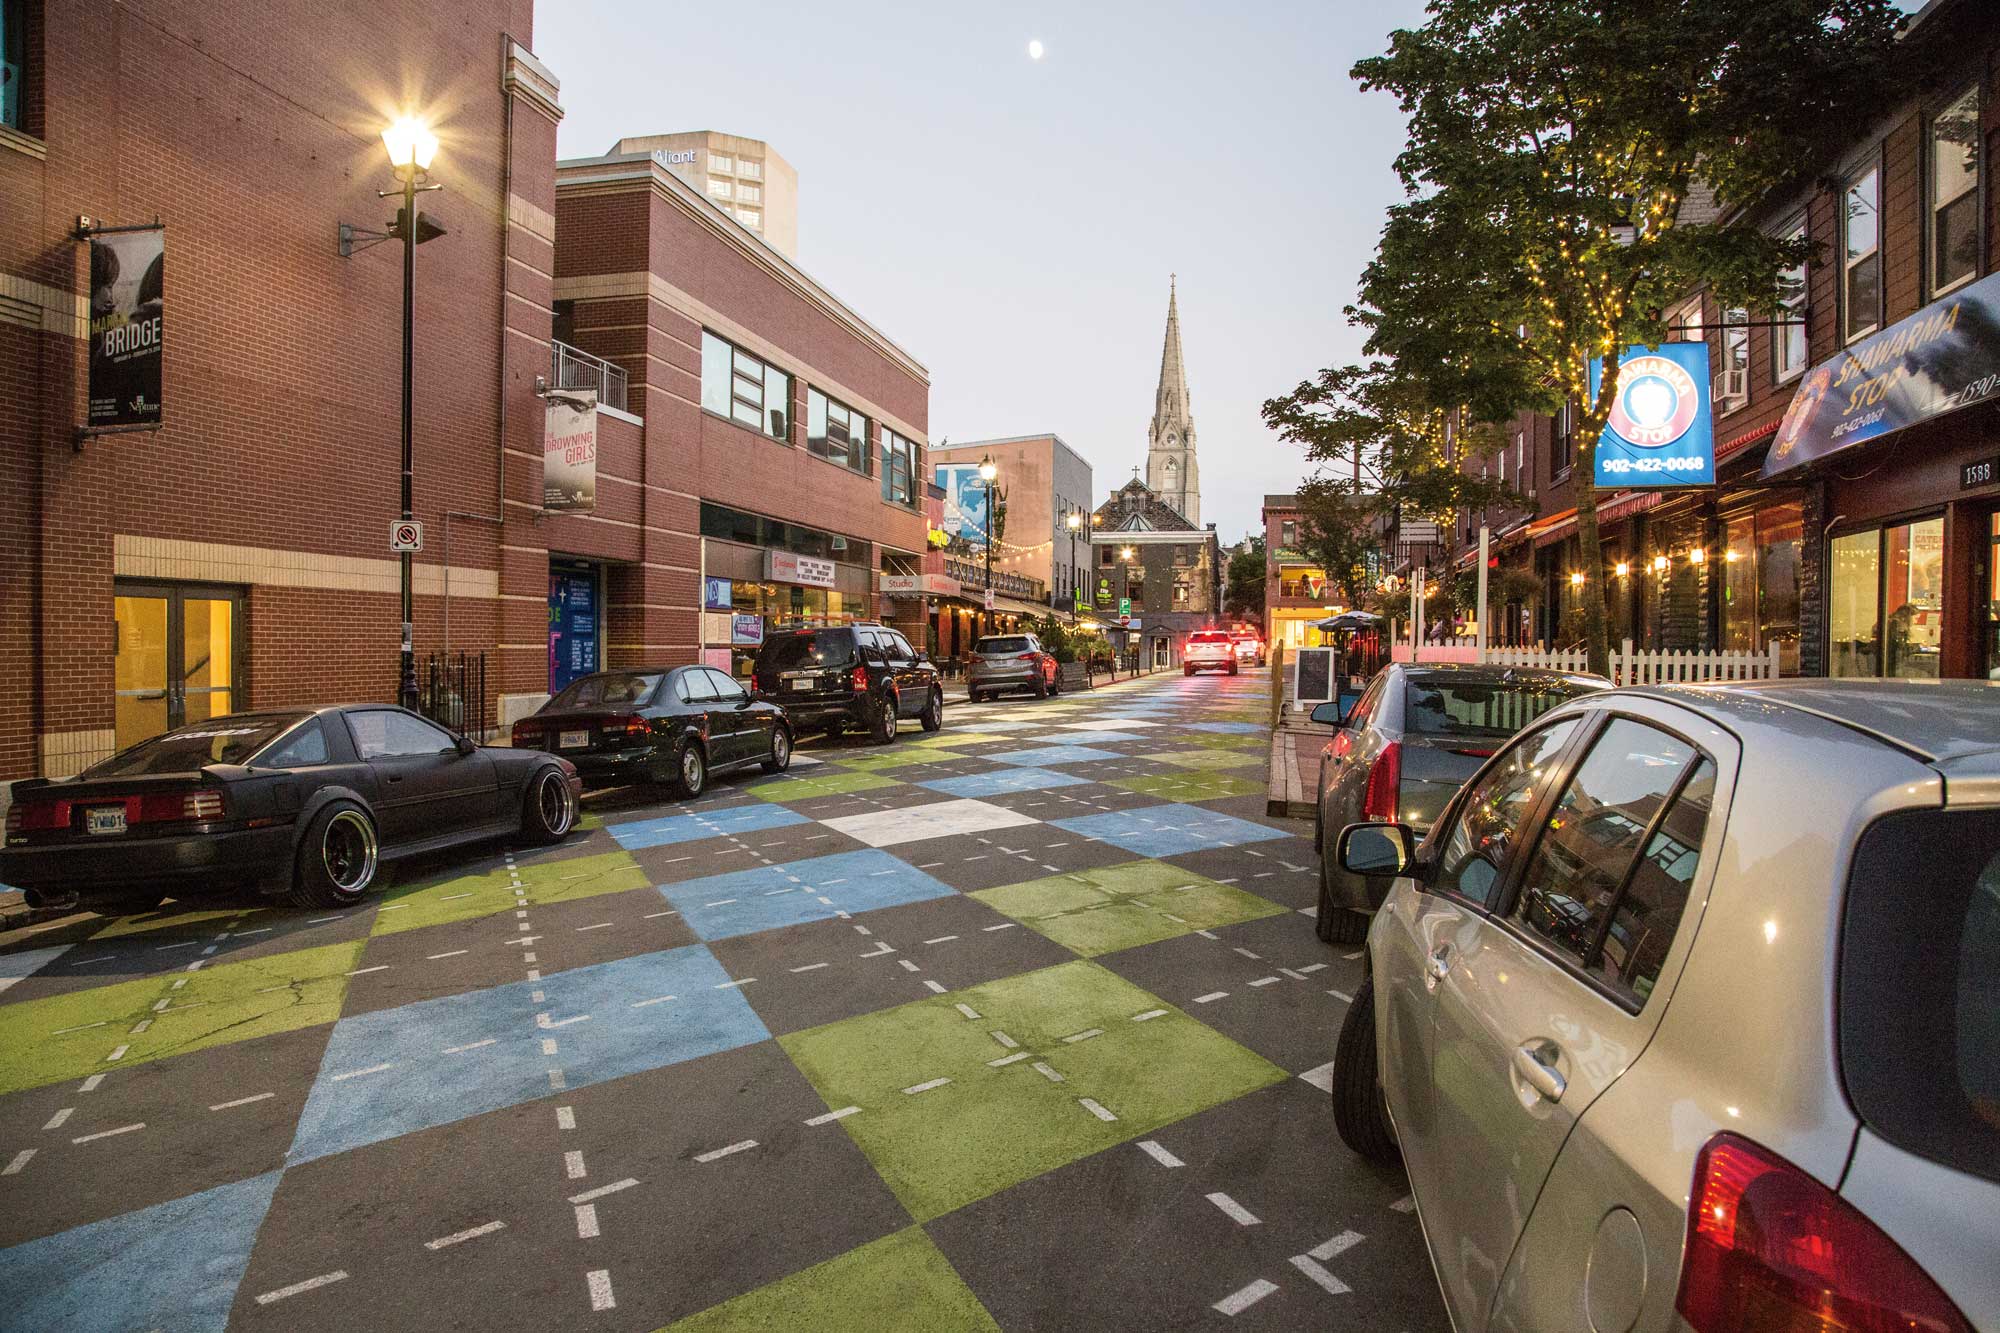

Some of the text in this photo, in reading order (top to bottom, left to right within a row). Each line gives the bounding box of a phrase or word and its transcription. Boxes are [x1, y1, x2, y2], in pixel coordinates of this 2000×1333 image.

[655, 149, 696, 163] Aliant
[105, 317, 161, 357] BRIDGE
[1833, 303, 1960, 388] SHAWARMA
[1842, 365, 1904, 416] STOP
[545, 431, 593, 453] DROWNING
[1628, 425, 1673, 443] STOP
[565, 443, 595, 464] GIRLS
[1602, 456, 1704, 473] 902-422-0068
[1966, 463, 1990, 484] 1588
[888, 579, 914, 588] Studio
[1121, 600, 1129, 608] P
